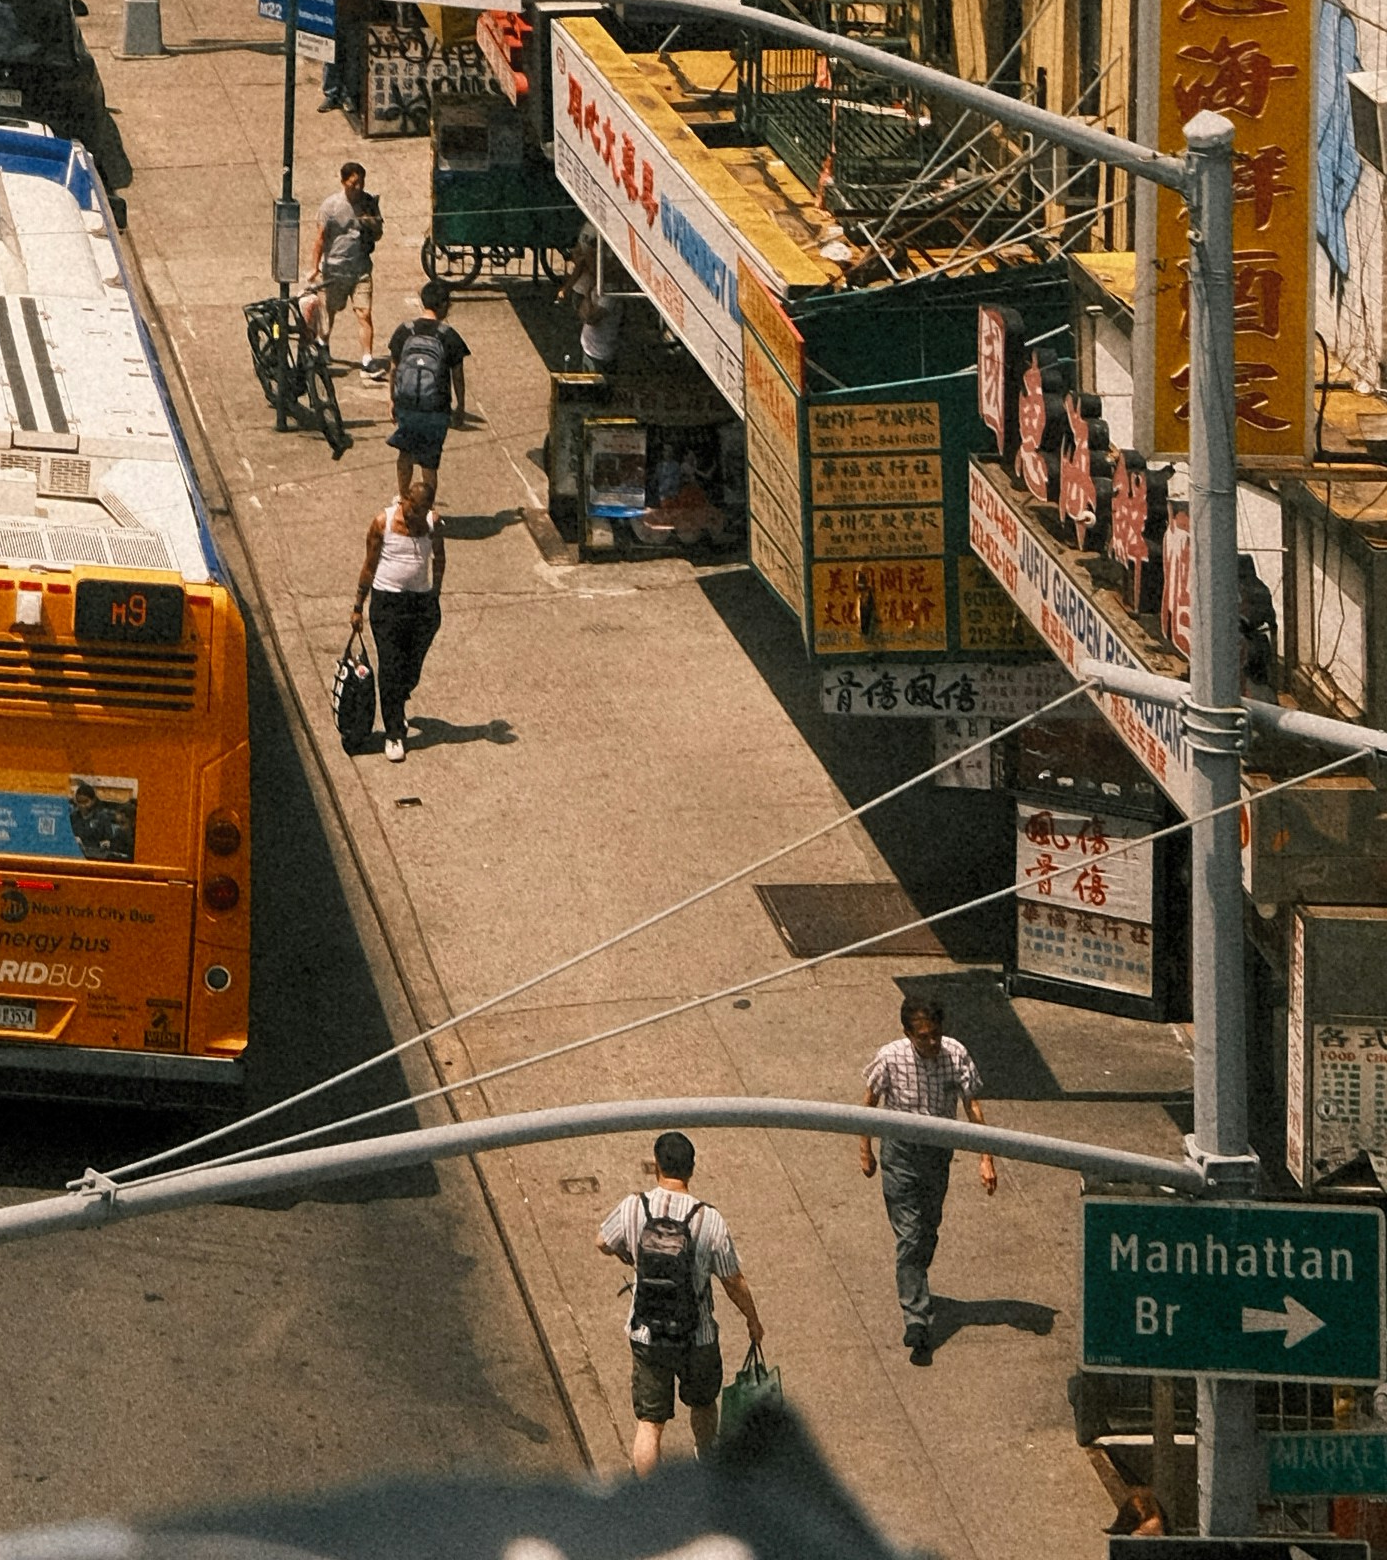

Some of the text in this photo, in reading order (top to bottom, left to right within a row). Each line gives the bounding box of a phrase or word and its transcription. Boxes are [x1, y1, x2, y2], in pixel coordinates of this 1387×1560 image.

[259, 1, 283, 20] M22
[1018, 529, 1049, 601] JUFU
[1052, 569, 1102, 659] GARDEN
[110, 594, 148, 626] M9
[32, 902, 61, 917] New
[68, 904, 94, 918] York
[97, 905, 125, 922] City
[69, 931, 111, 953] bus
[1320, 1050, 1356, 1062] FOOD
[1110, 1232, 1354, 1282] Manhattan
[1135, 1295, 1181, 1336] Br
